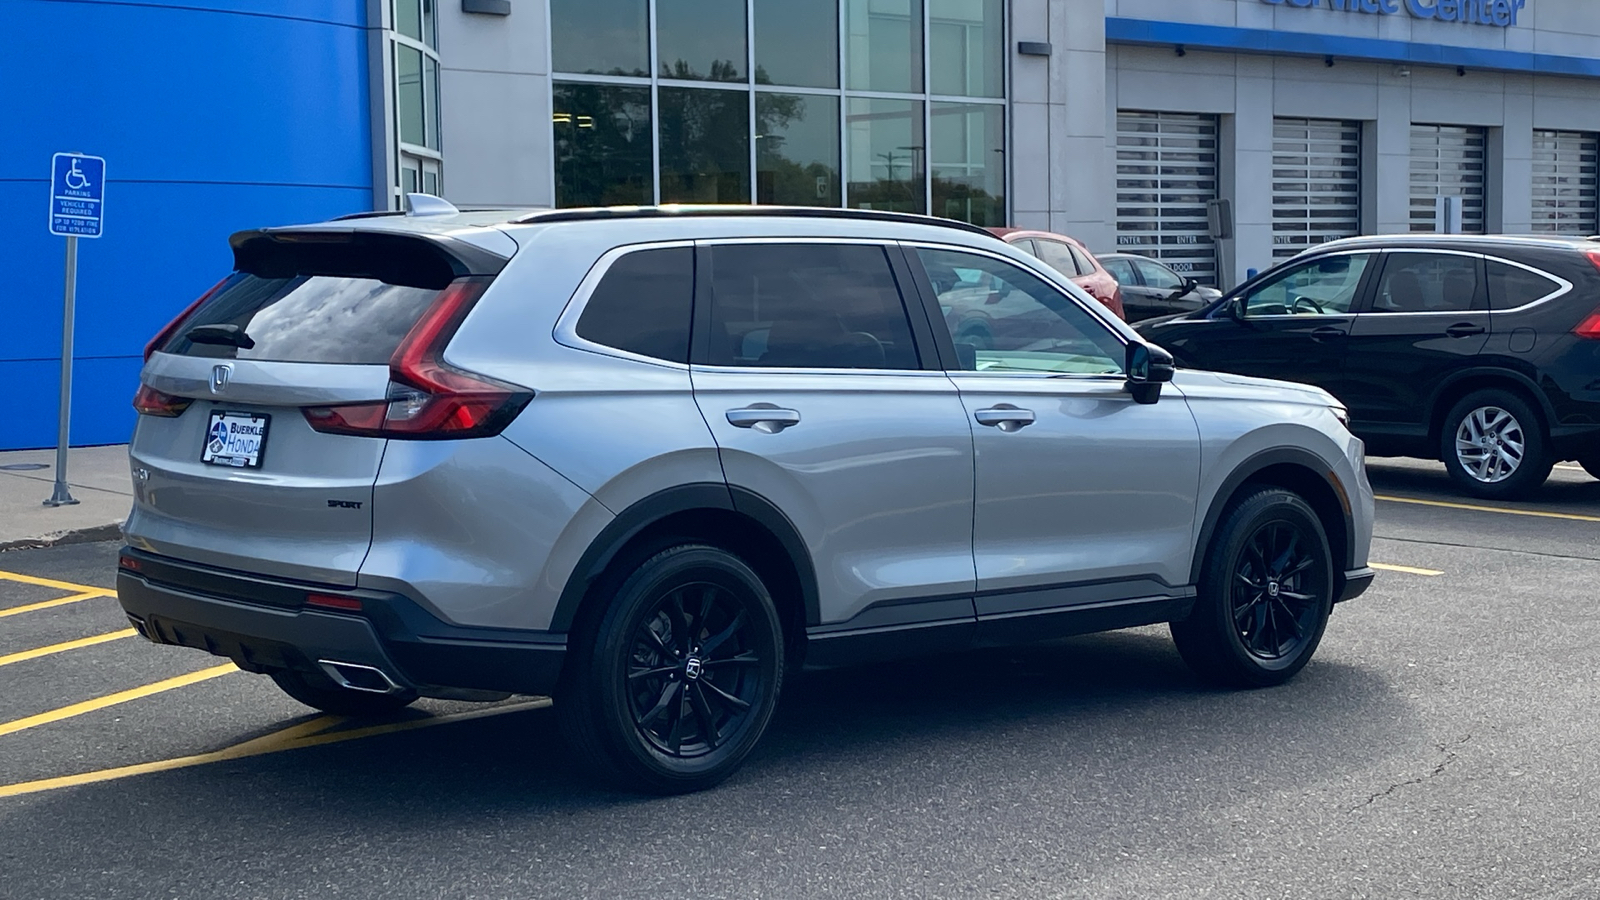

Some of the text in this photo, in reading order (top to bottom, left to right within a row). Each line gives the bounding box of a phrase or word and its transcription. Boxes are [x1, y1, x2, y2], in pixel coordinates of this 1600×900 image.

[1120, 236, 1141, 244] ENTER
[1176, 235, 1198, 244] ENTER
[1173, 263, 1194, 272] DOOR
[230, 422, 263, 435] BUERKLE
[226, 433, 260, 454] HONDA
[327, 499, 363, 509] SPORT
